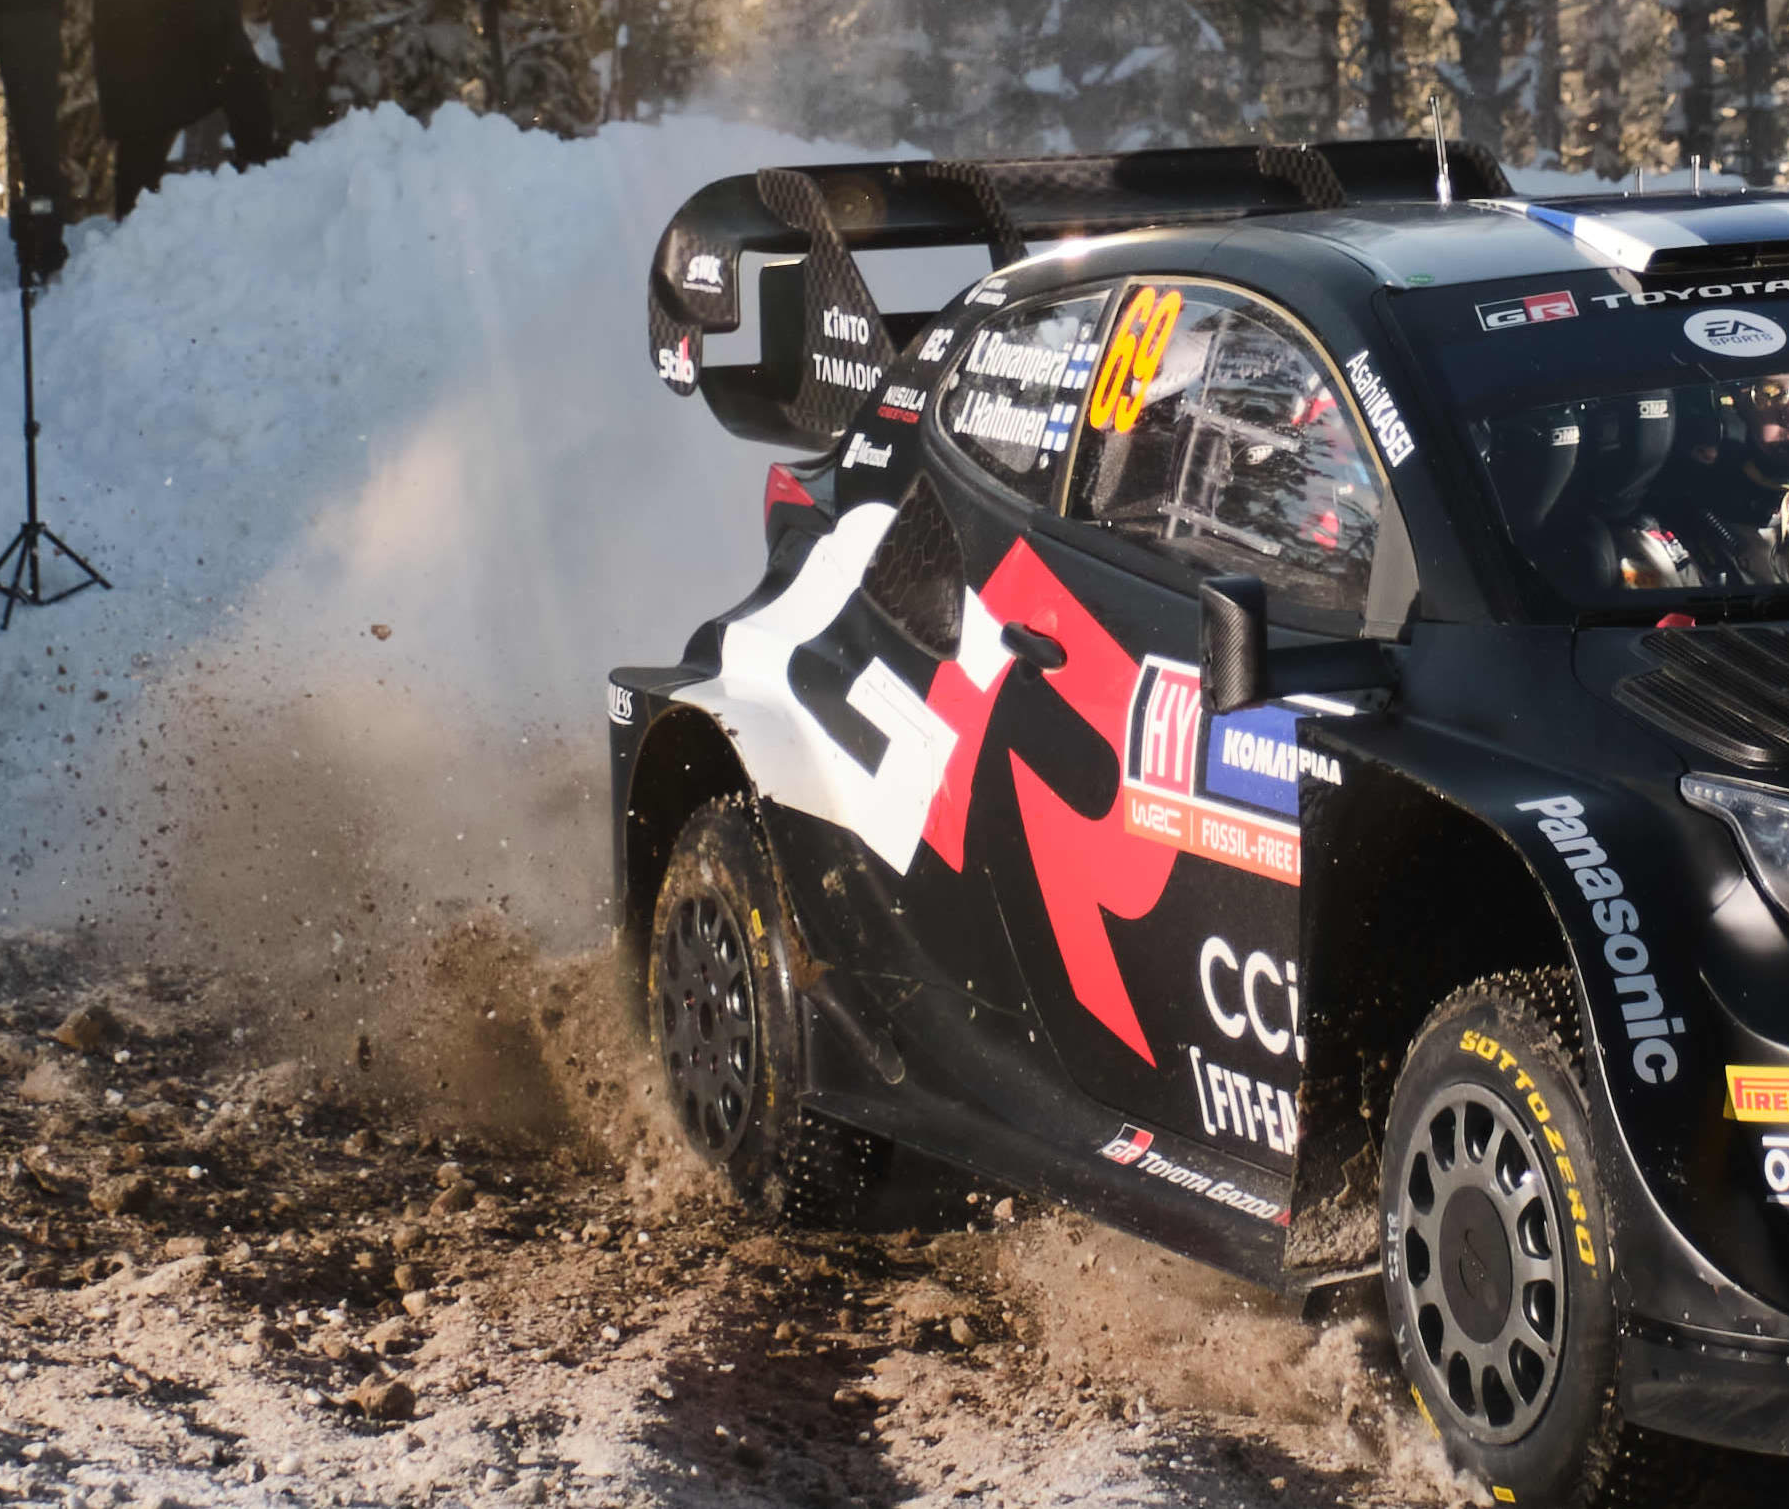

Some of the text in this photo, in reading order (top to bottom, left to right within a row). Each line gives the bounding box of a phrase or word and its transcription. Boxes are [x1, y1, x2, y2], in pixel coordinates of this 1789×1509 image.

[824, 306, 870, 345] KINTO
[1485, 301, 1572, 328] GR
[1704, 319, 1762, 338] EA
[659, 336, 694, 384] Stilo
[1089, 286, 1183, 434] 69
[1710, 331, 1774, 347] SPORTS
[1346, 350, 1416, 468] AsahiKASEI
[1299, 748, 1343, 786] PIAA
[1132, 798, 1182, 838] WRC
[1202, 818, 1293, 873] FOSSIL-FREE
[1515, 795, 1686, 1084] Panasonic
[1459, 1029, 1597, 1267] SOTTOZERO
[1137, 1150, 1212, 1193] TOYOTA
[1205, 1182, 1280, 1220] GAZOO
